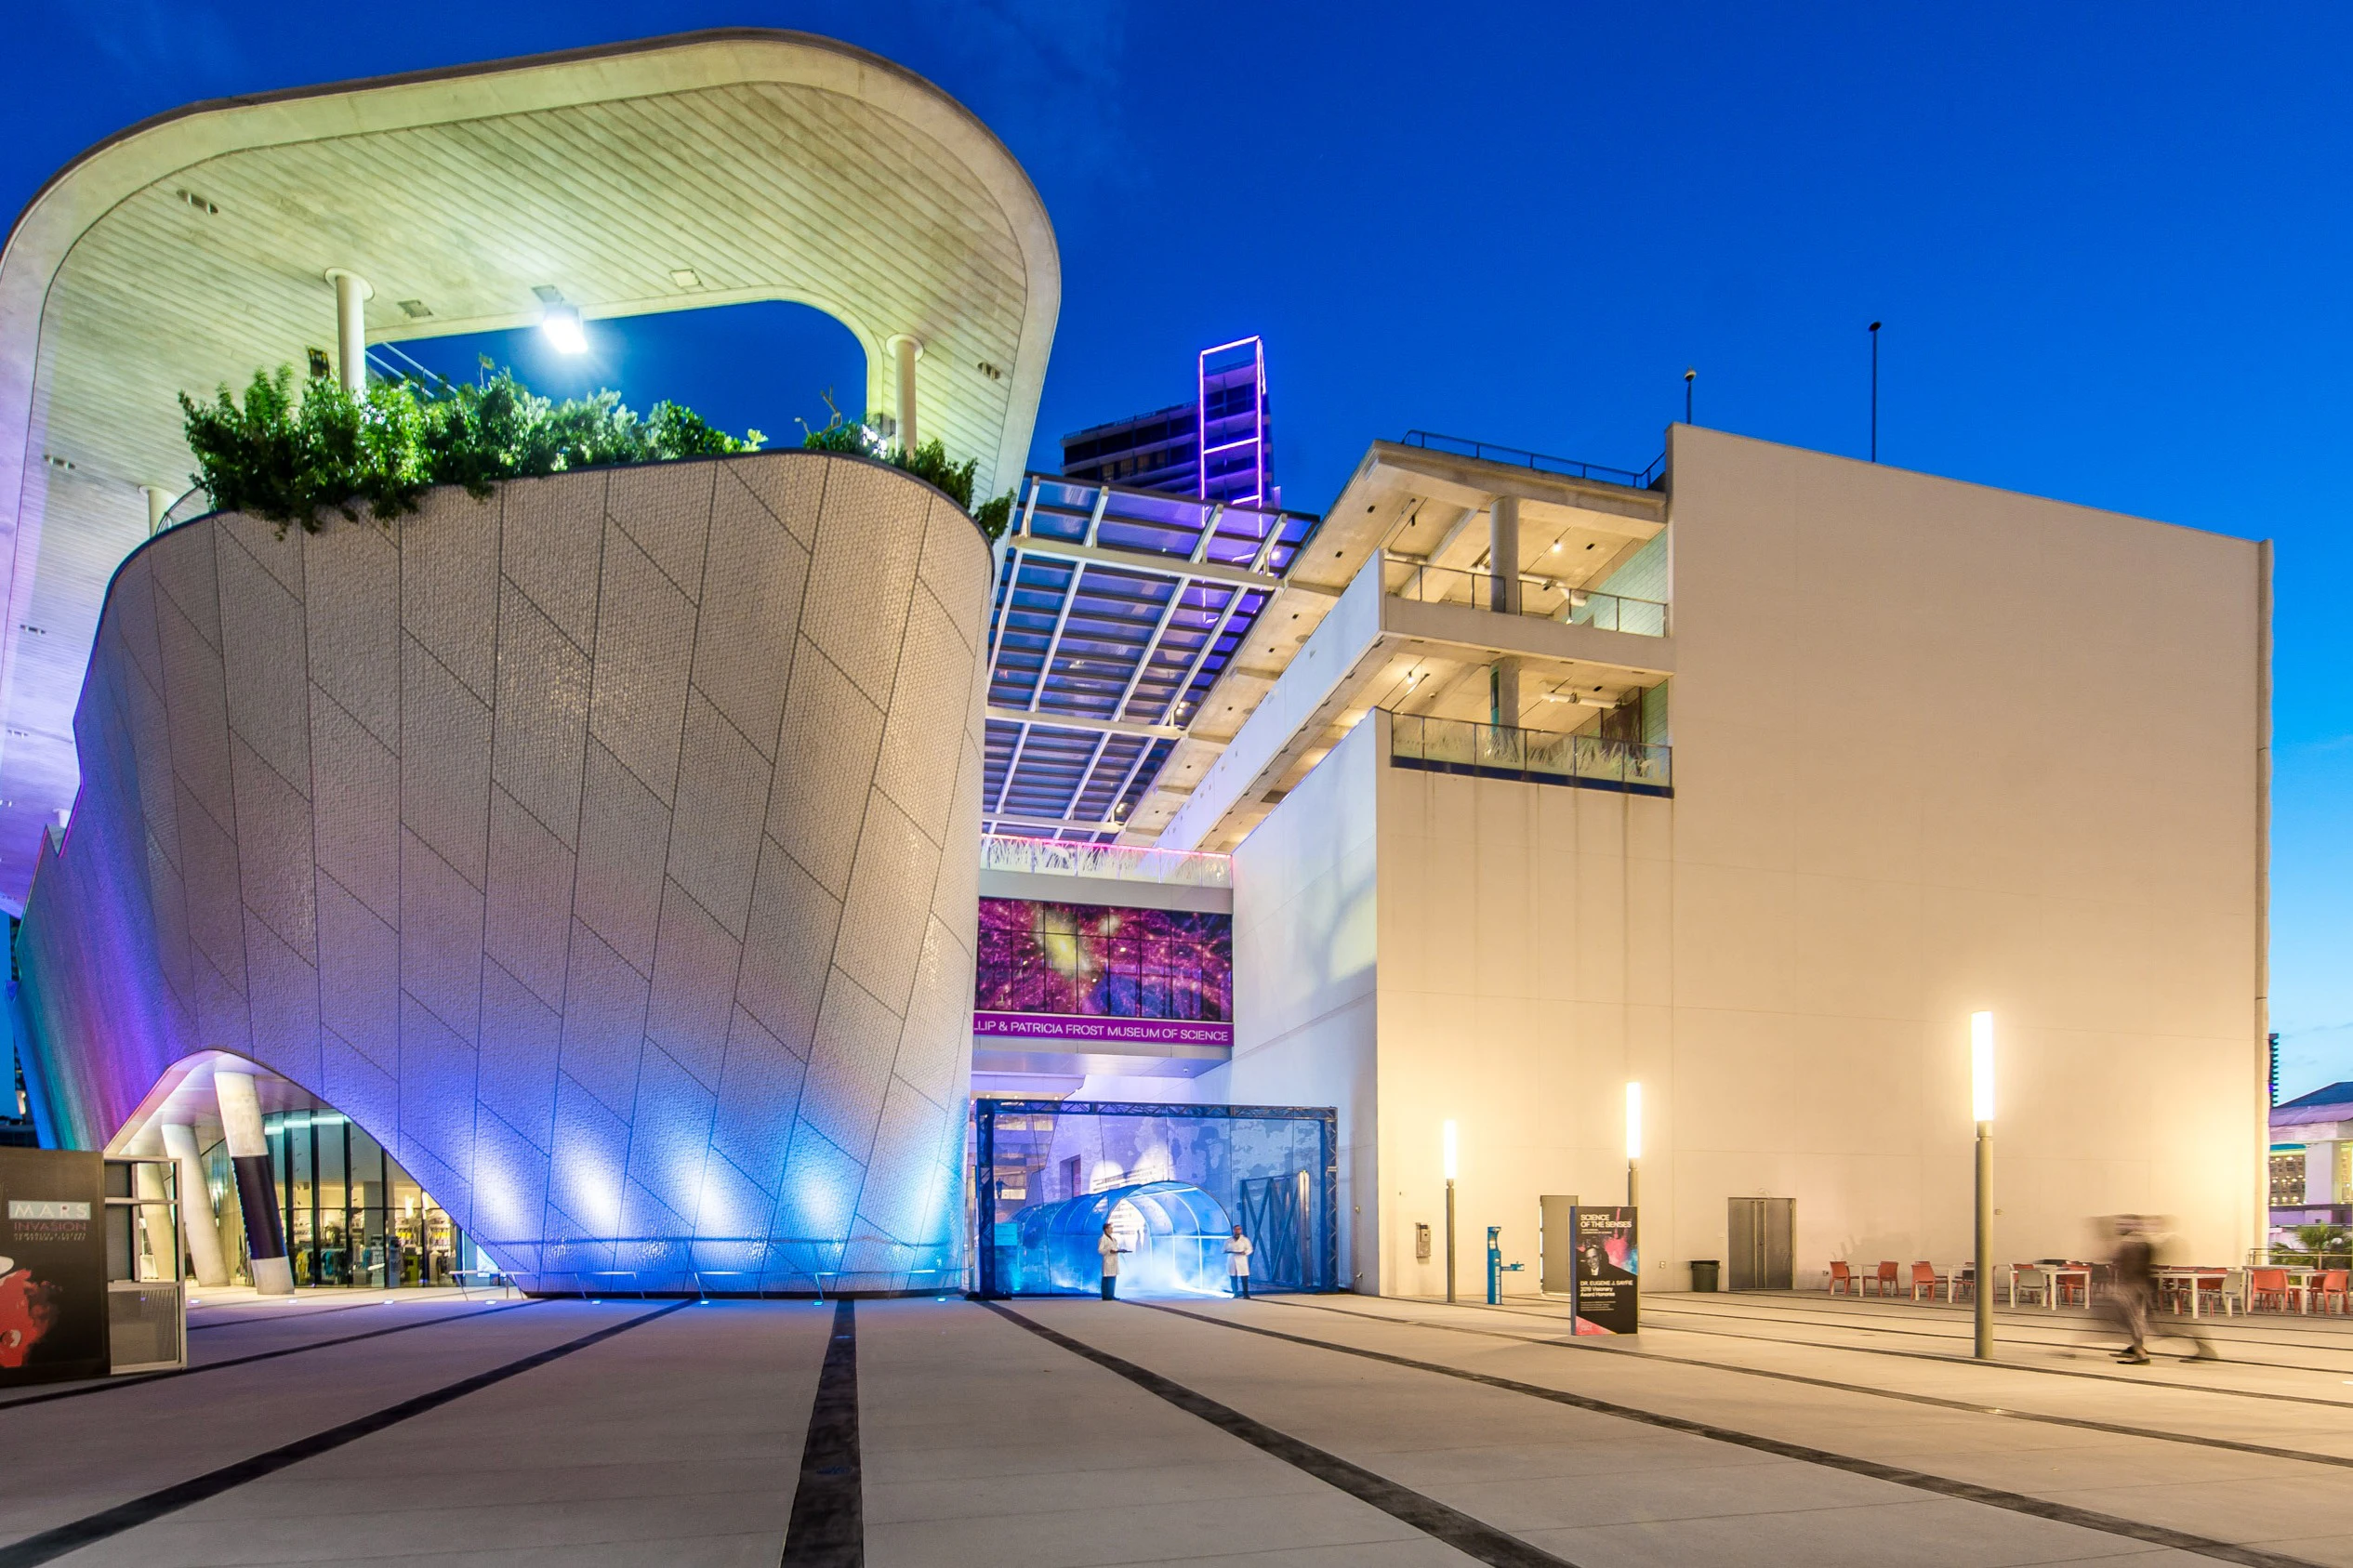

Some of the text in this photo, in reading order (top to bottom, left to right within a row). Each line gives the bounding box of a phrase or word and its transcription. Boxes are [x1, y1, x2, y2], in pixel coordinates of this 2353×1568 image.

[998, 1021, 1008, 1032] &
[1011, 1021, 1063, 1034] PATRICIA
[1065, 1023, 1104, 1036] FROST
[1107, 1026, 1160, 1038] MUSEUM
[1162, 1028, 1178, 1038] OF
[1180, 1029, 1228, 1041] SCIENCE
[15, 1204, 87, 1218] MARS
[14, 1221, 86, 1232] INVASION
